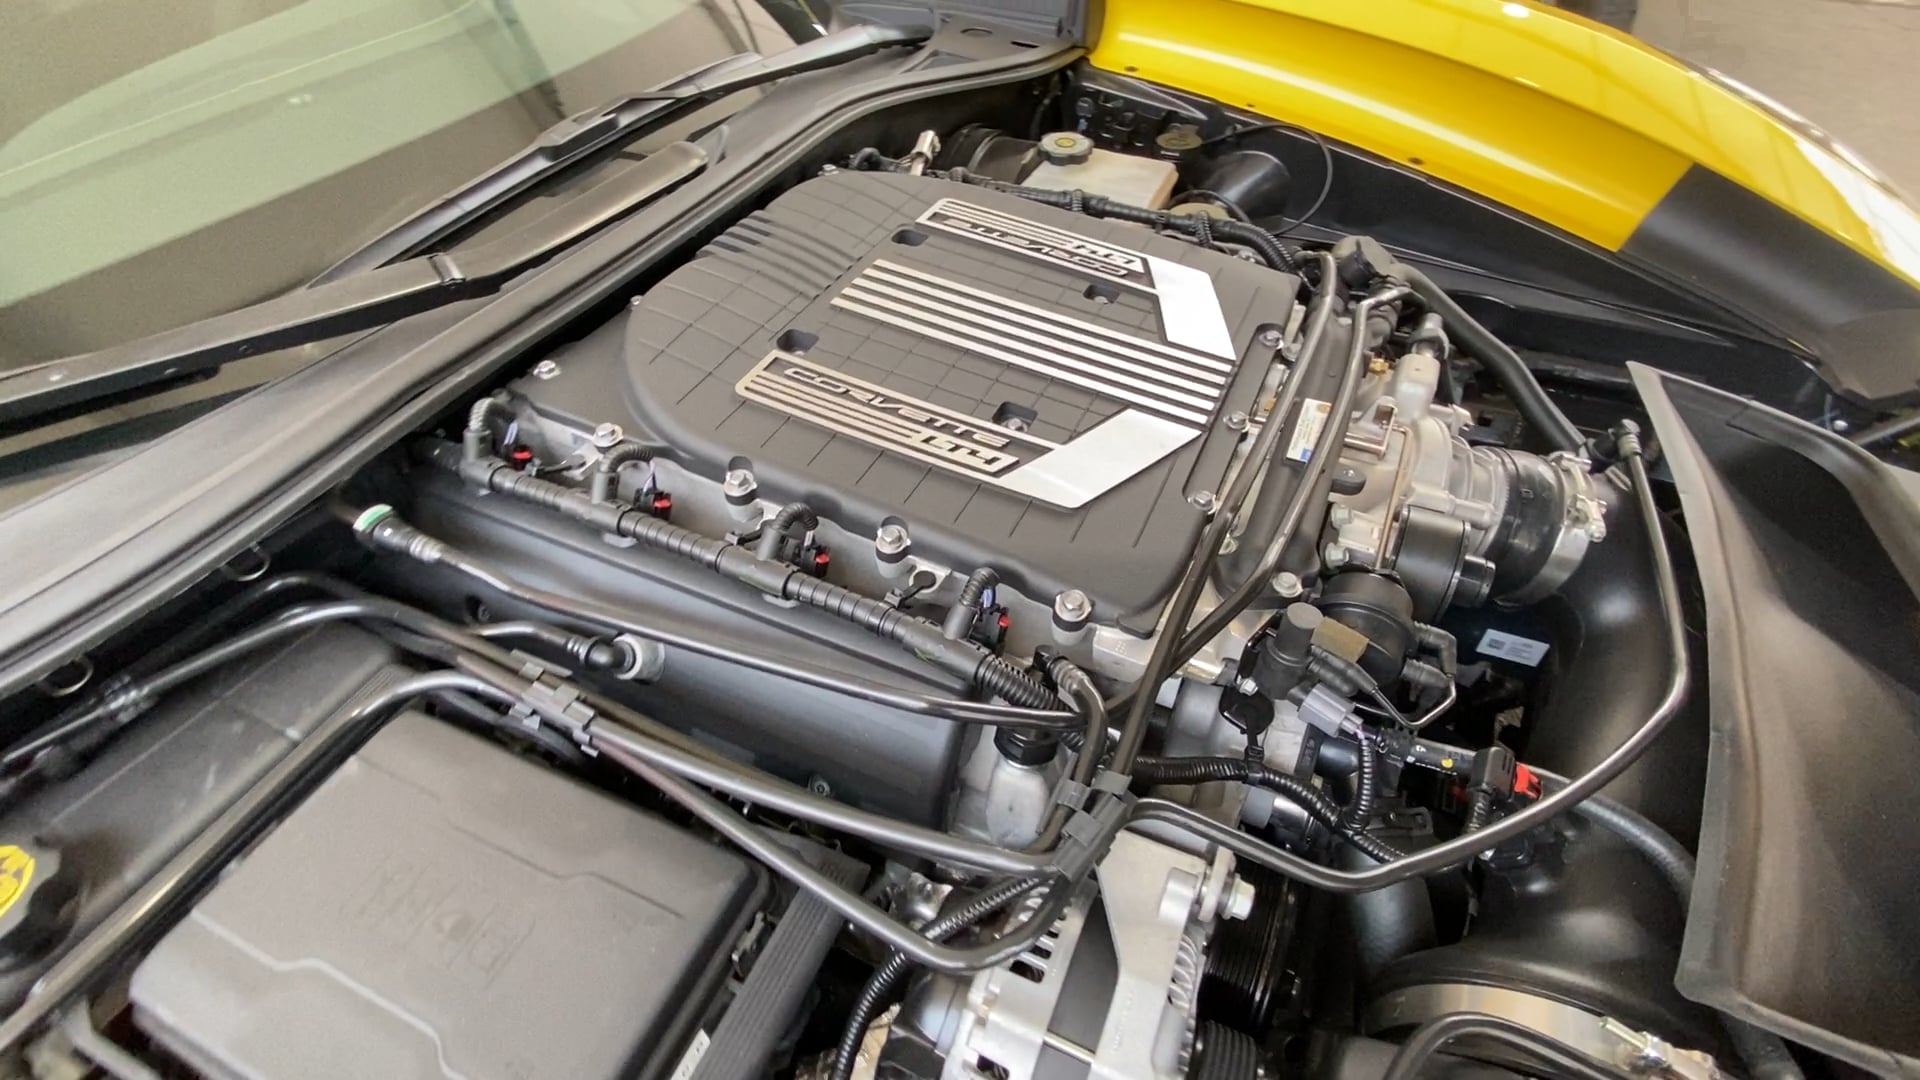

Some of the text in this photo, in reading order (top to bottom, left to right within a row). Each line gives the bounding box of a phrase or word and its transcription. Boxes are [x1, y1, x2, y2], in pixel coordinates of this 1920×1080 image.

[942, 219, 1129, 276] CORVETTE
[784, 367, 1011, 448] CORVETTE
[921, 435, 1001, 467] LT4
